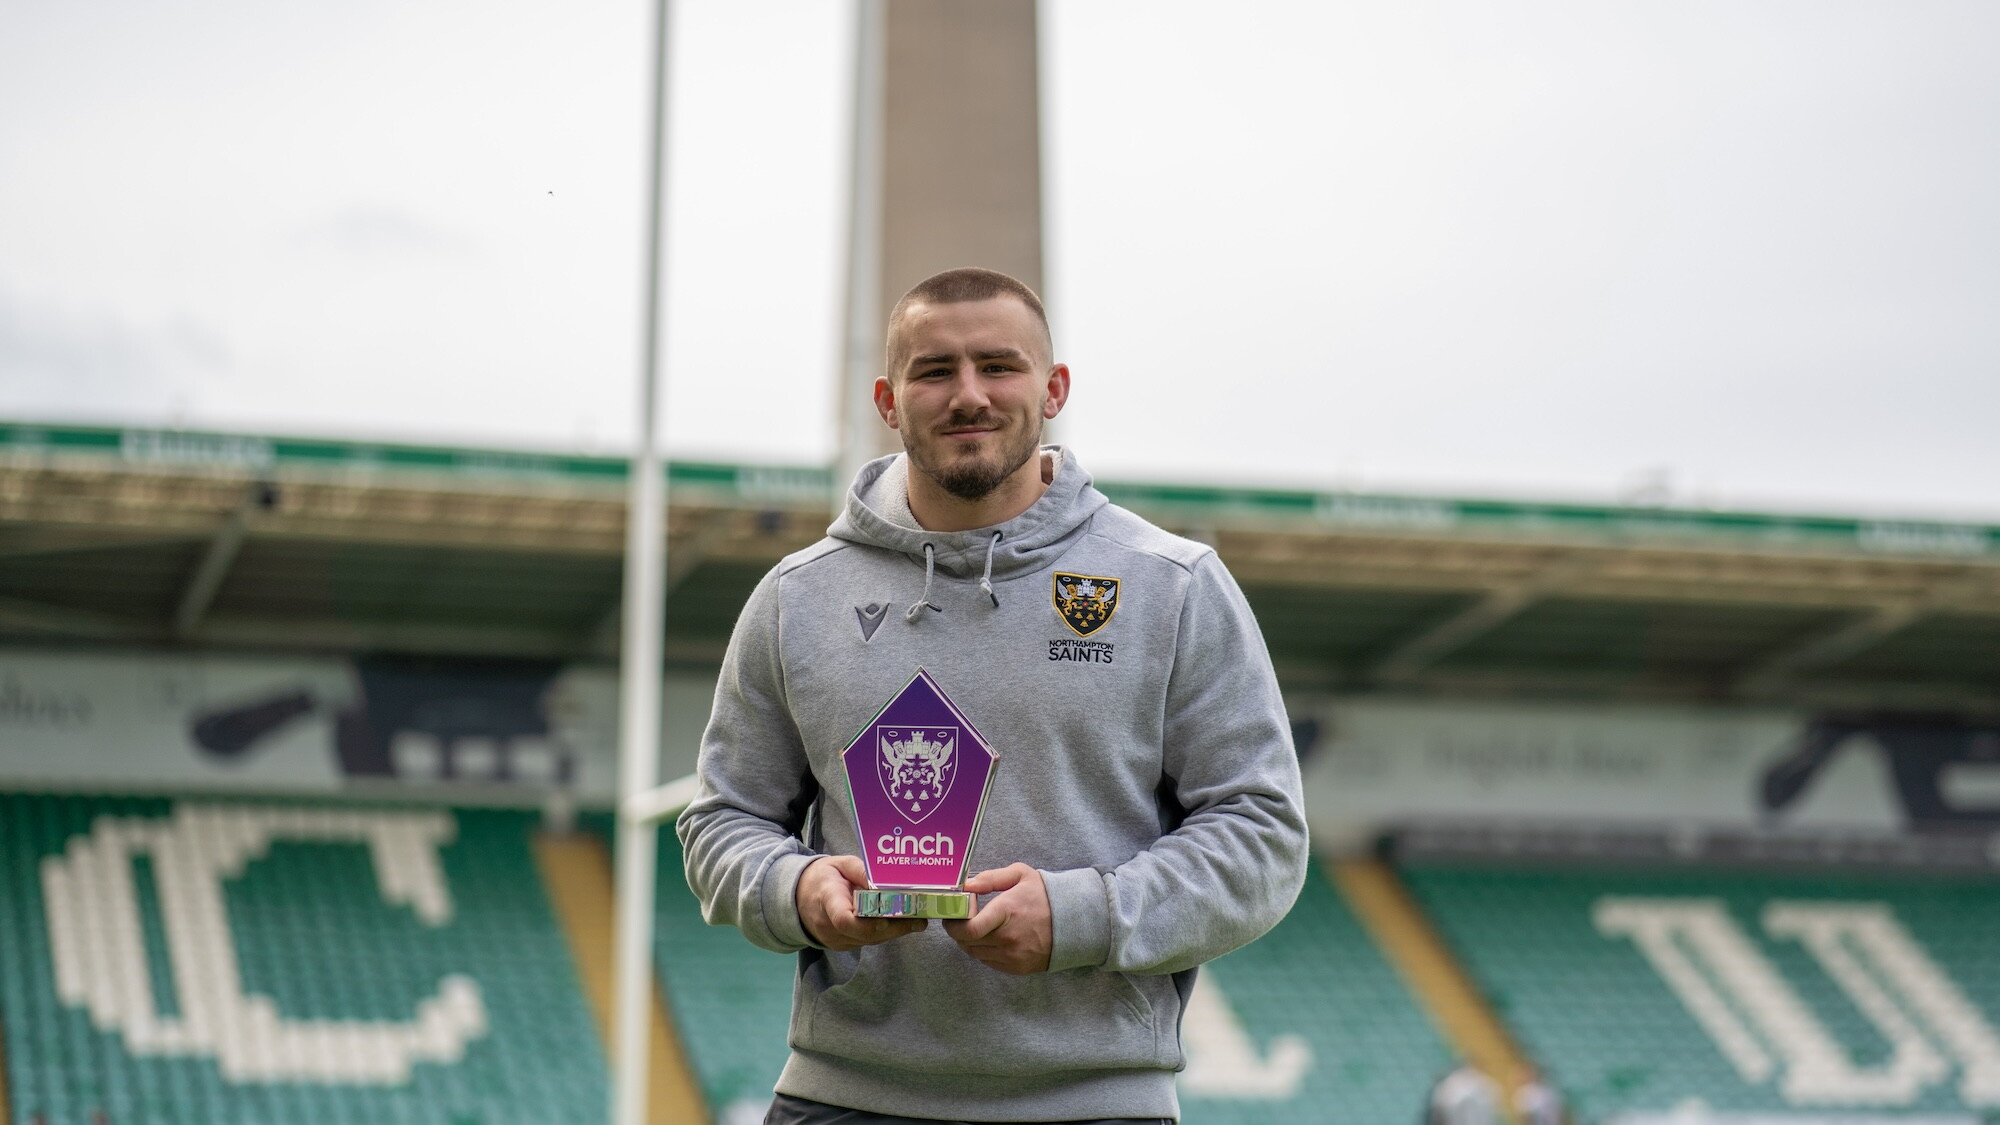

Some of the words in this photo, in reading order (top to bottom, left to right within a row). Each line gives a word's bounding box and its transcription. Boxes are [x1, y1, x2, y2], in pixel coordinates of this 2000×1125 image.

[1048, 639, 1114, 651] NORTHAMPTON
[1048, 647, 1113, 664] SAINTS
[877, 826, 954, 855] cinch
[877, 856, 910, 865] PLAYER
[918, 857, 954, 866] MONTH
